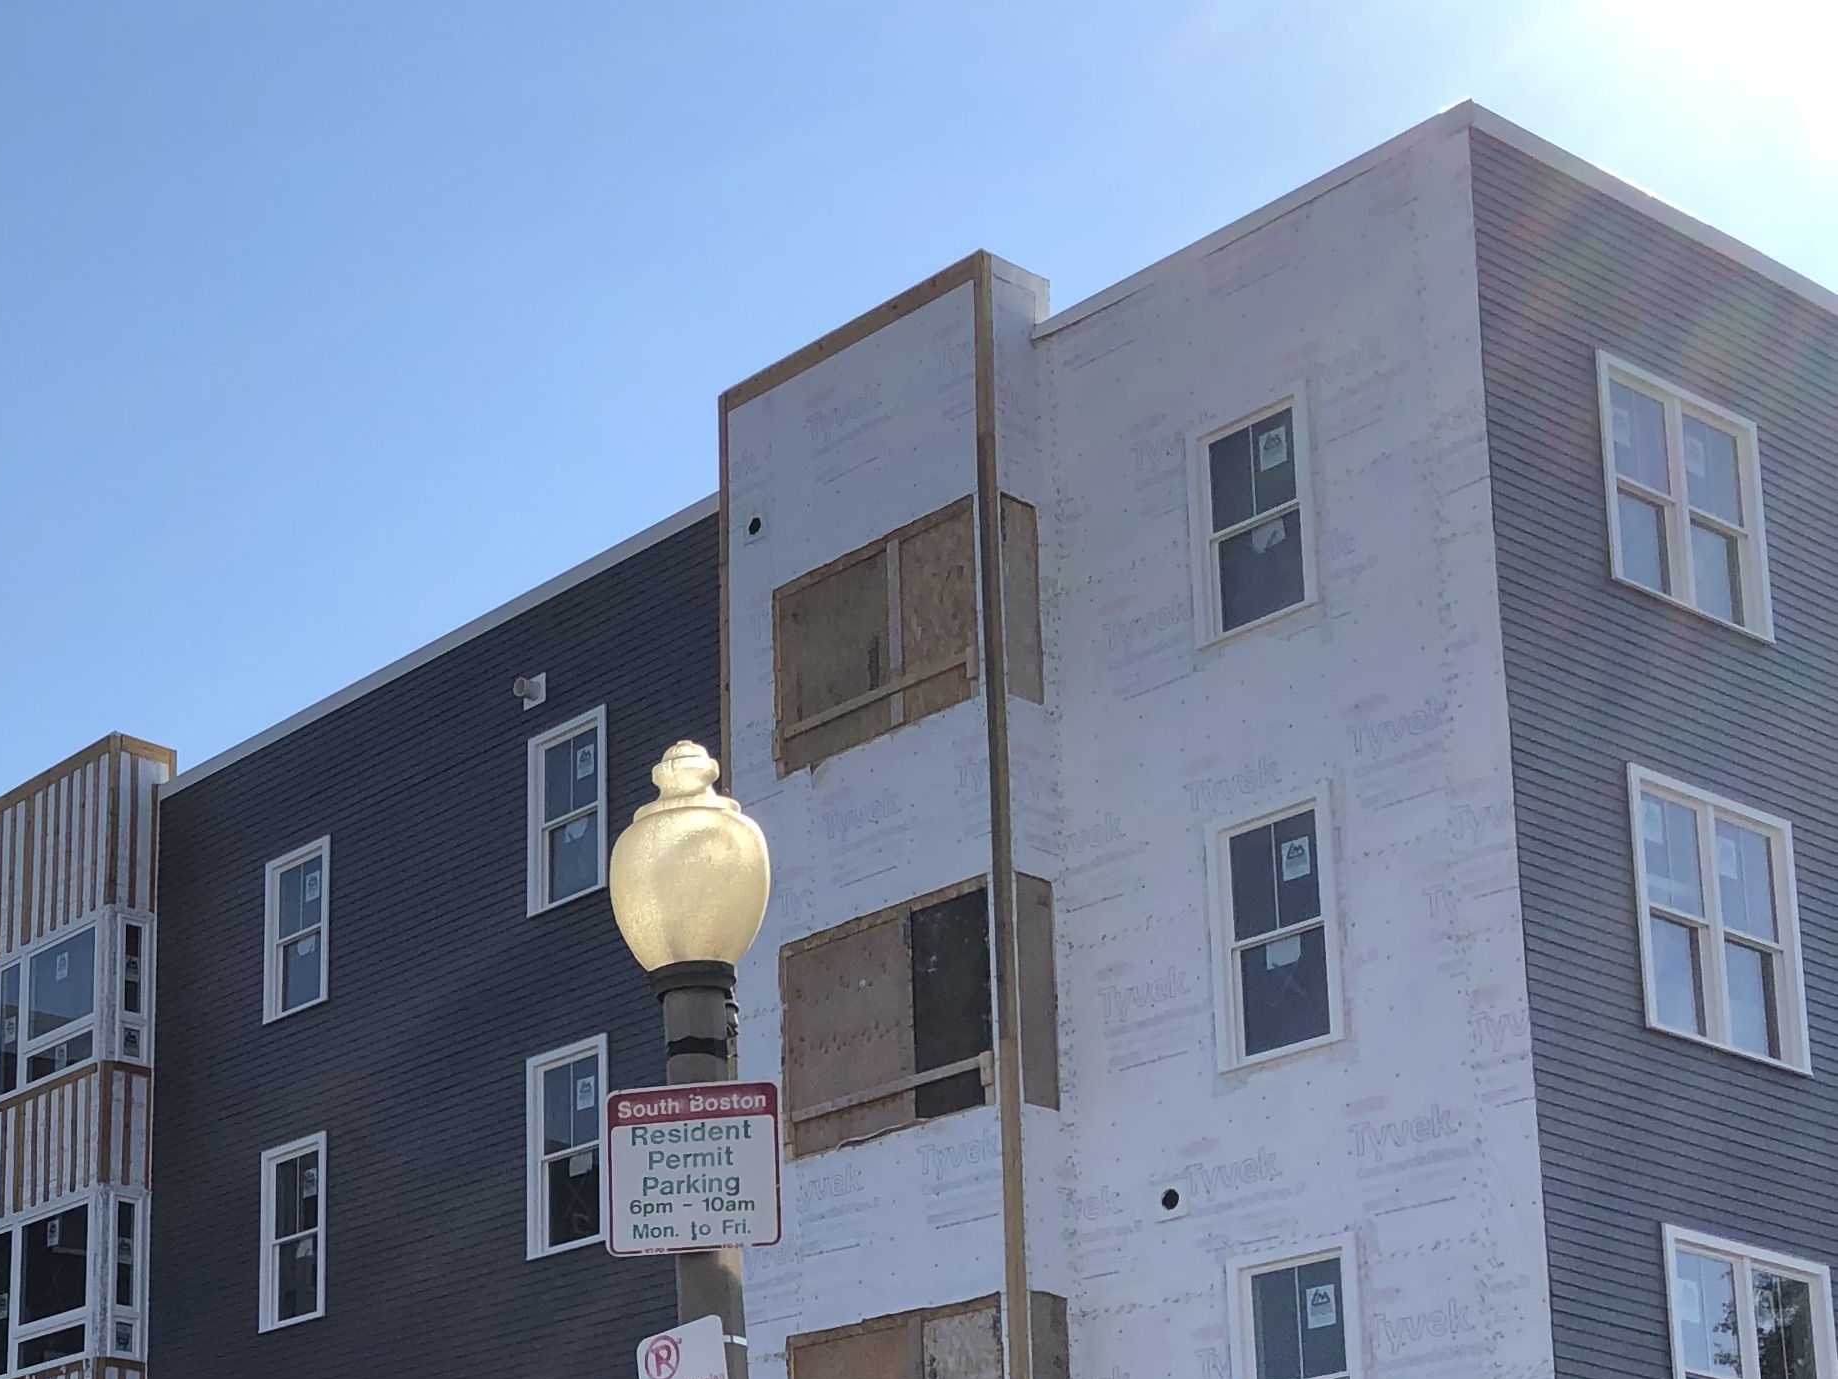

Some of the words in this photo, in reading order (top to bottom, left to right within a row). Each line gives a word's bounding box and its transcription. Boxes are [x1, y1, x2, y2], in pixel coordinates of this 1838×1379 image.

[1347, 697, 1448, 759] Tyvek
[1184, 757, 1282, 812] Tyvek
[1097, 966, 1191, 1022] Tyvek
[617, 1097, 680, 1119] South
[689, 1093, 767, 1113] Boston
[631, 1120, 752, 1147] Resident
[1348, 1103, 1458, 1159] Tyvek
[648, 1146, 734, 1171] Permit
[917, 1129, 1002, 1177] Tyvek
[642, 1174, 740, 1197] Parking
[1187, 1147, 1283, 1200] Tyvek
[629, 1199, 673, 1217] 6pm
[703, 1197, 755, 1213] 10am
[632, 1223, 680, 1240] Mon.
[690, 1221, 711, 1240] to
[722, 1219, 751, 1235] Fri.
